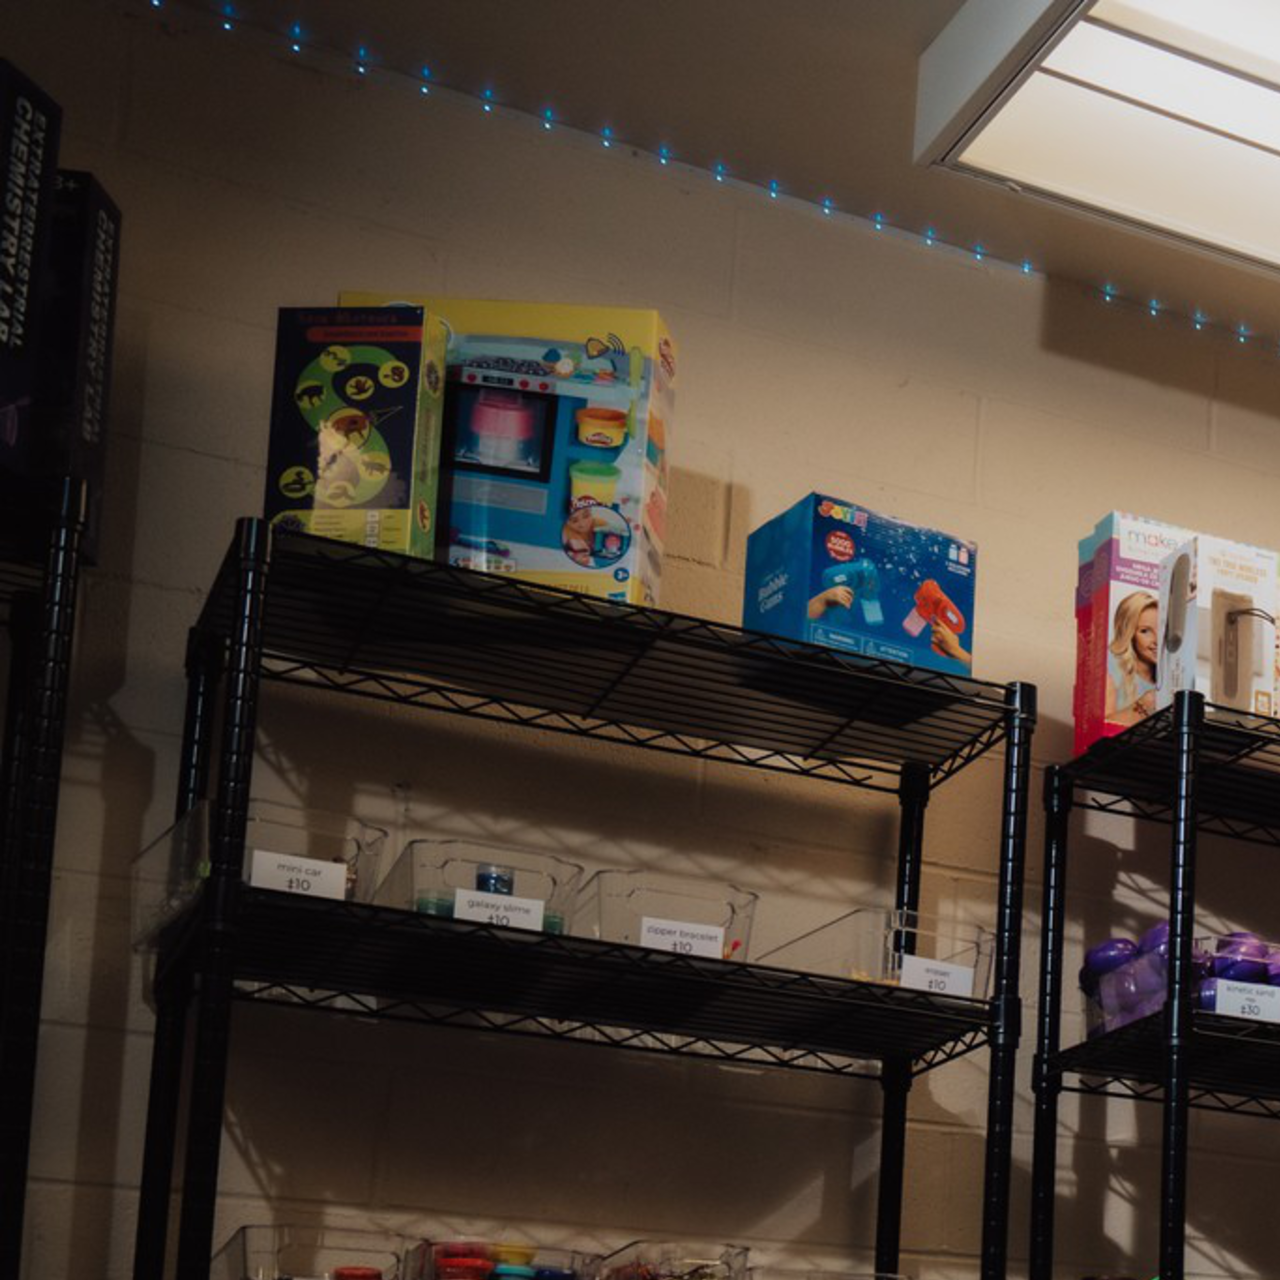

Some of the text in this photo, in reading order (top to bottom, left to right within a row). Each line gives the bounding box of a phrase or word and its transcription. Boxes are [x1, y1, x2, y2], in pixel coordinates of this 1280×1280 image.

[4, 96, 32, 285] CHEMISTRY
[277, 863, 323, 876] mini car
[468, 898, 500, 913] galaxy
